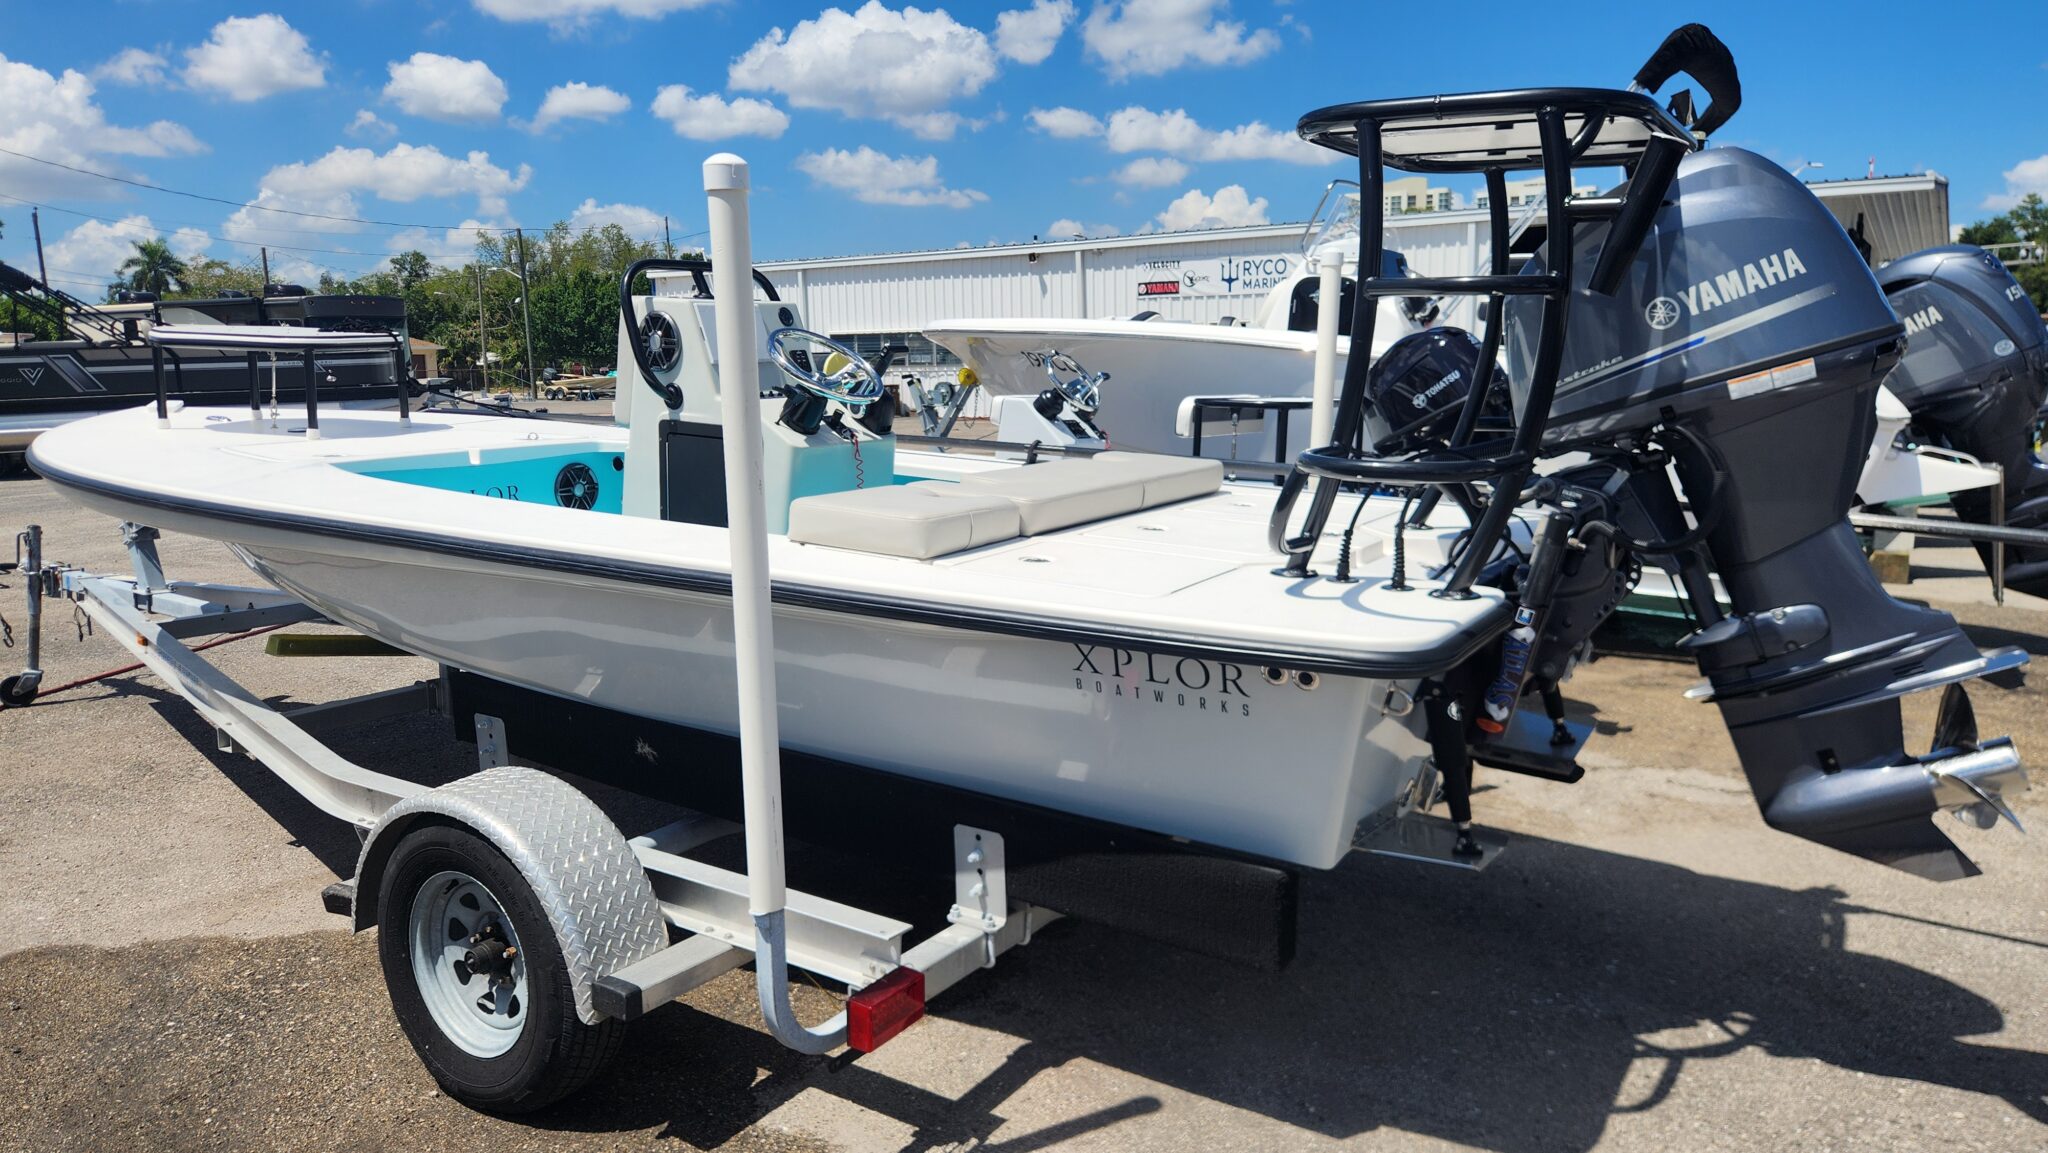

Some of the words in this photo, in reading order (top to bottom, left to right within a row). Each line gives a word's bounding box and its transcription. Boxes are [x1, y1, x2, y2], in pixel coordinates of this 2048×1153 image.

[1243, 258, 1287, 276] RYCO
[1677, 248, 1807, 316] YAMAHA
[1904, 305, 1944, 336] AHA
[1424, 369, 1461, 398] TOHATSU
[1073, 643, 1250, 698] XPLOR
[1075, 677, 1250, 717] BOATWORKS
